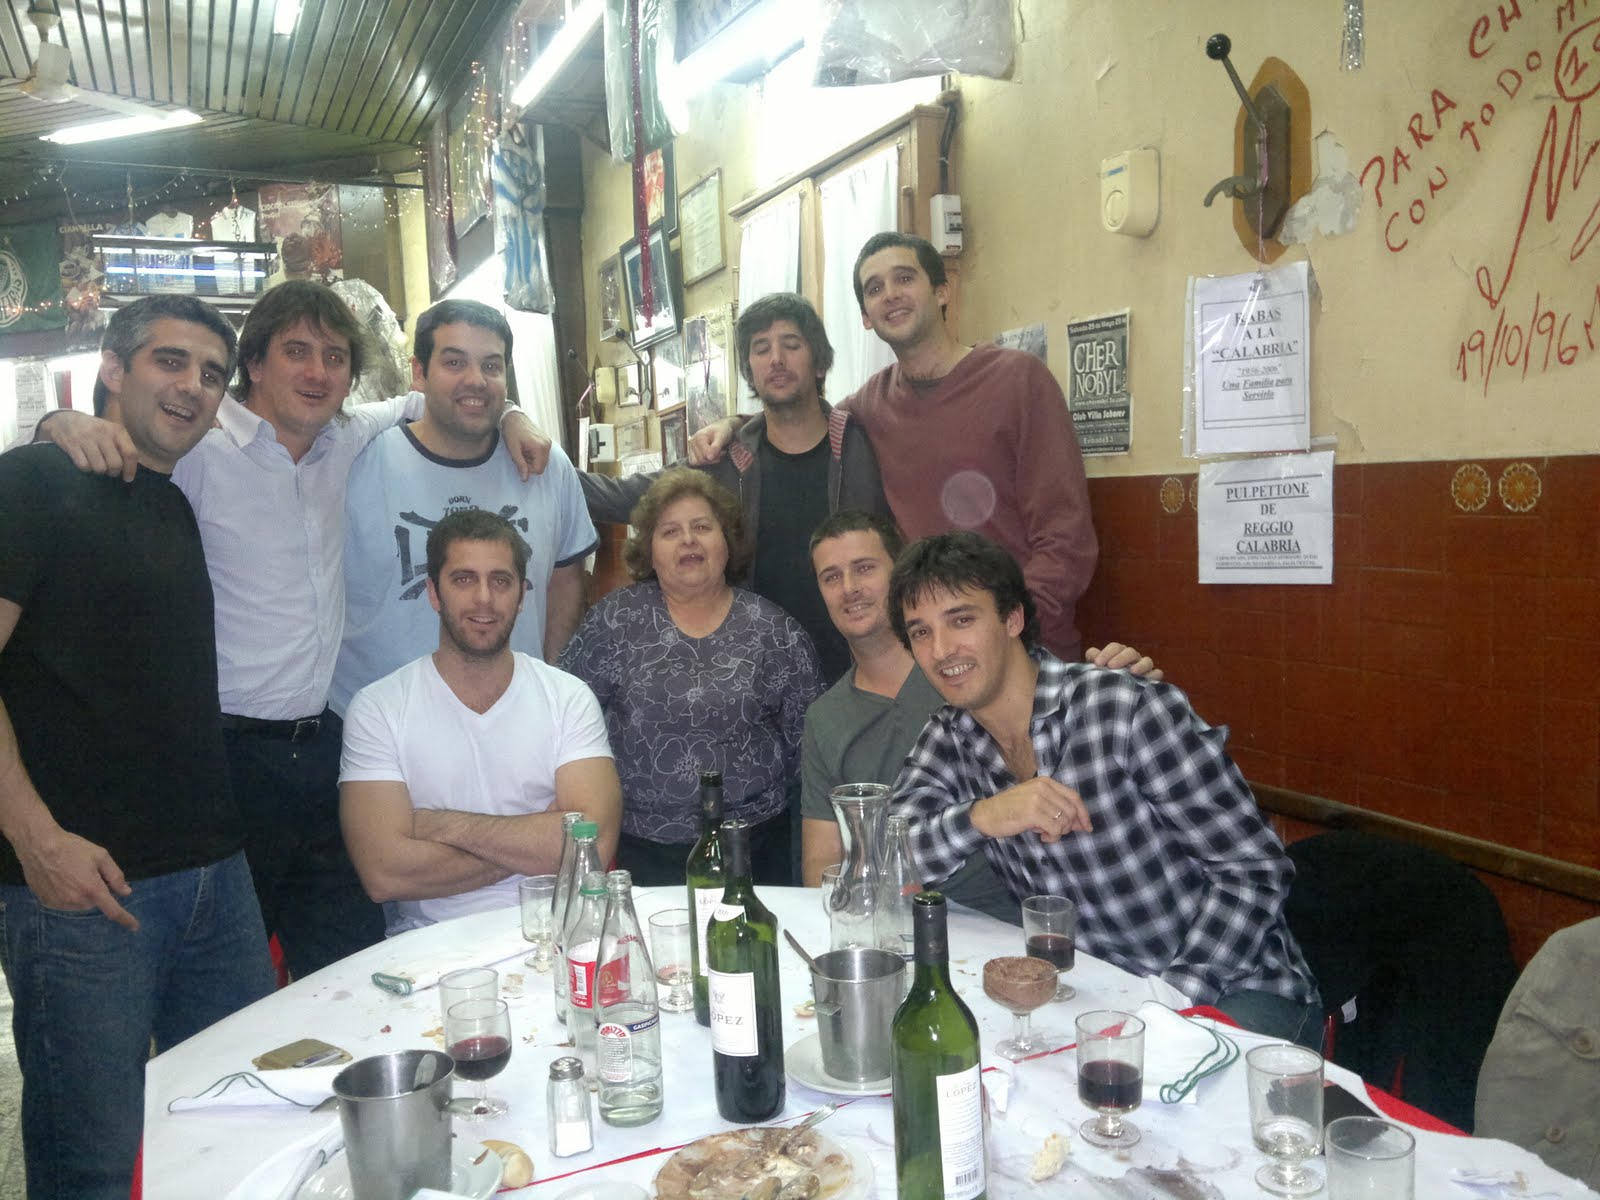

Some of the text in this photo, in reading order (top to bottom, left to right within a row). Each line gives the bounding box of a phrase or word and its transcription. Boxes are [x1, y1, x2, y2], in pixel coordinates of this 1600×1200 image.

[1360, 0, 1522, 207] PARA CH
[1385, 166, 1448, 252] CON
[1235, 308, 1282, 325] RABAS
[1242, 327, 1275, 340] A LA
[1457, 290, 1579, 398] 19/10/96
[1073, 340, 1120, 373] CHER
[1075, 369, 1120, 398] NOBYL
[1222, 377, 1293, 390] Una Familia para
[1073, 412, 1087, 421] Club
[1087, 411, 1102, 420] Villa
[1226, 482, 1309, 500] PULPETTONE
[1261, 503, 1276, 515] DE
[1244, 521, 1293, 535] REGGIO
[1236, 540, 1301, 553] CALABRIA
[711, 1010, 744, 1026] OPEZ
